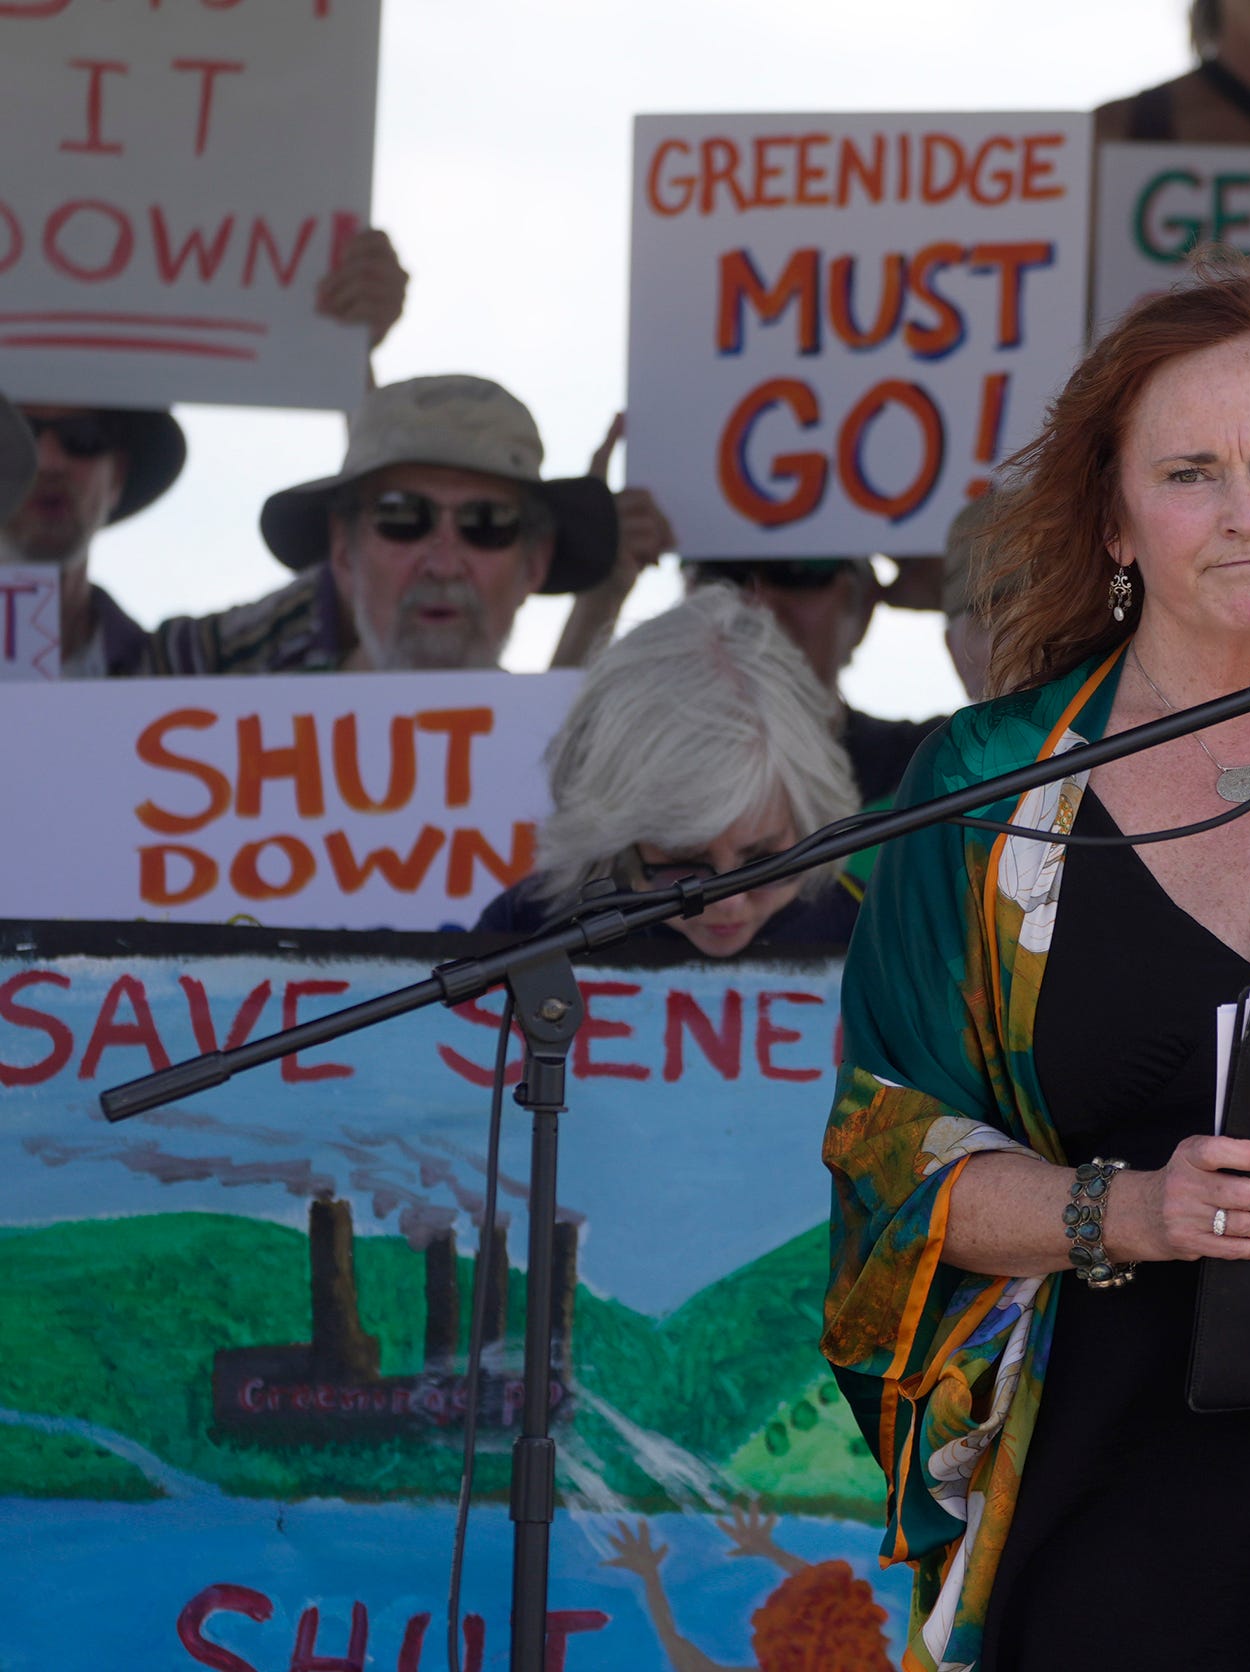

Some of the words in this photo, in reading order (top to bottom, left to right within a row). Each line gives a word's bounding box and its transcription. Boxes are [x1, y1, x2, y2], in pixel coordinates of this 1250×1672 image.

[58, 56, 249, 158] IT
[646, 131, 1068, 217] GREENIDGE
[715, 241, 1056, 363] MUST
[715, 369, 1012, 532] GO!
[134, 706, 494, 835] SHUT
[134, 822, 537, 907] DOWN
[0, 969, 355, 1088] SAVE
[436, 980, 843, 1088] SENE
